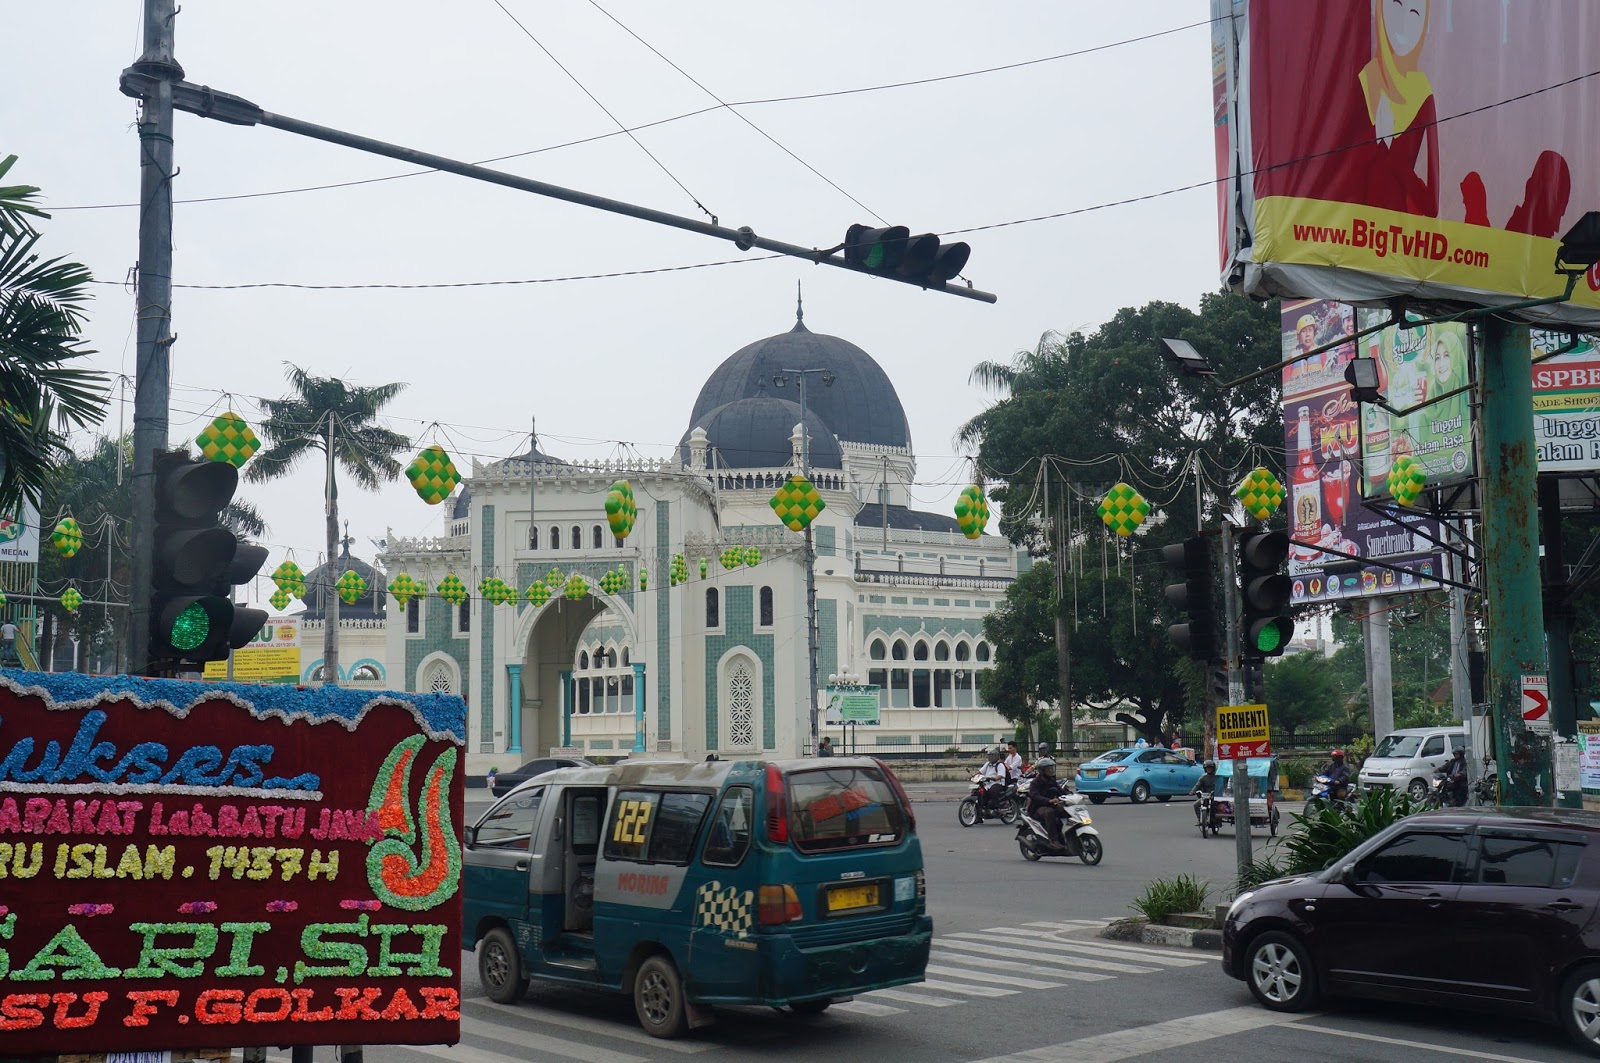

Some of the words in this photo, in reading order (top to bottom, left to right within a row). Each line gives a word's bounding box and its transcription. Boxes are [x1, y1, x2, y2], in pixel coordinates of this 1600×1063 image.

[1293, 218, 1489, 268] www.BigTvHD.com
[1431, 414, 1463, 434] Unggul
[1414, 440, 1440, 456] dalam
[1443, 434, 1465, 449] Rasa
[1537, 441, 1584, 463] alam
[1, 548, 29, 557] MEDAN
[1366, 528, 1411, 558] Superbrands
[1219, 710, 1267, 730] BERHENTI
[1221, 732, 1227, 740] DI
[1228, 731, 1252, 740] BELAKANG
[1253, 730, 1267, 738] GARIS
[0, 709, 275, 788] ukses
[613, 800, 652, 843] 122
